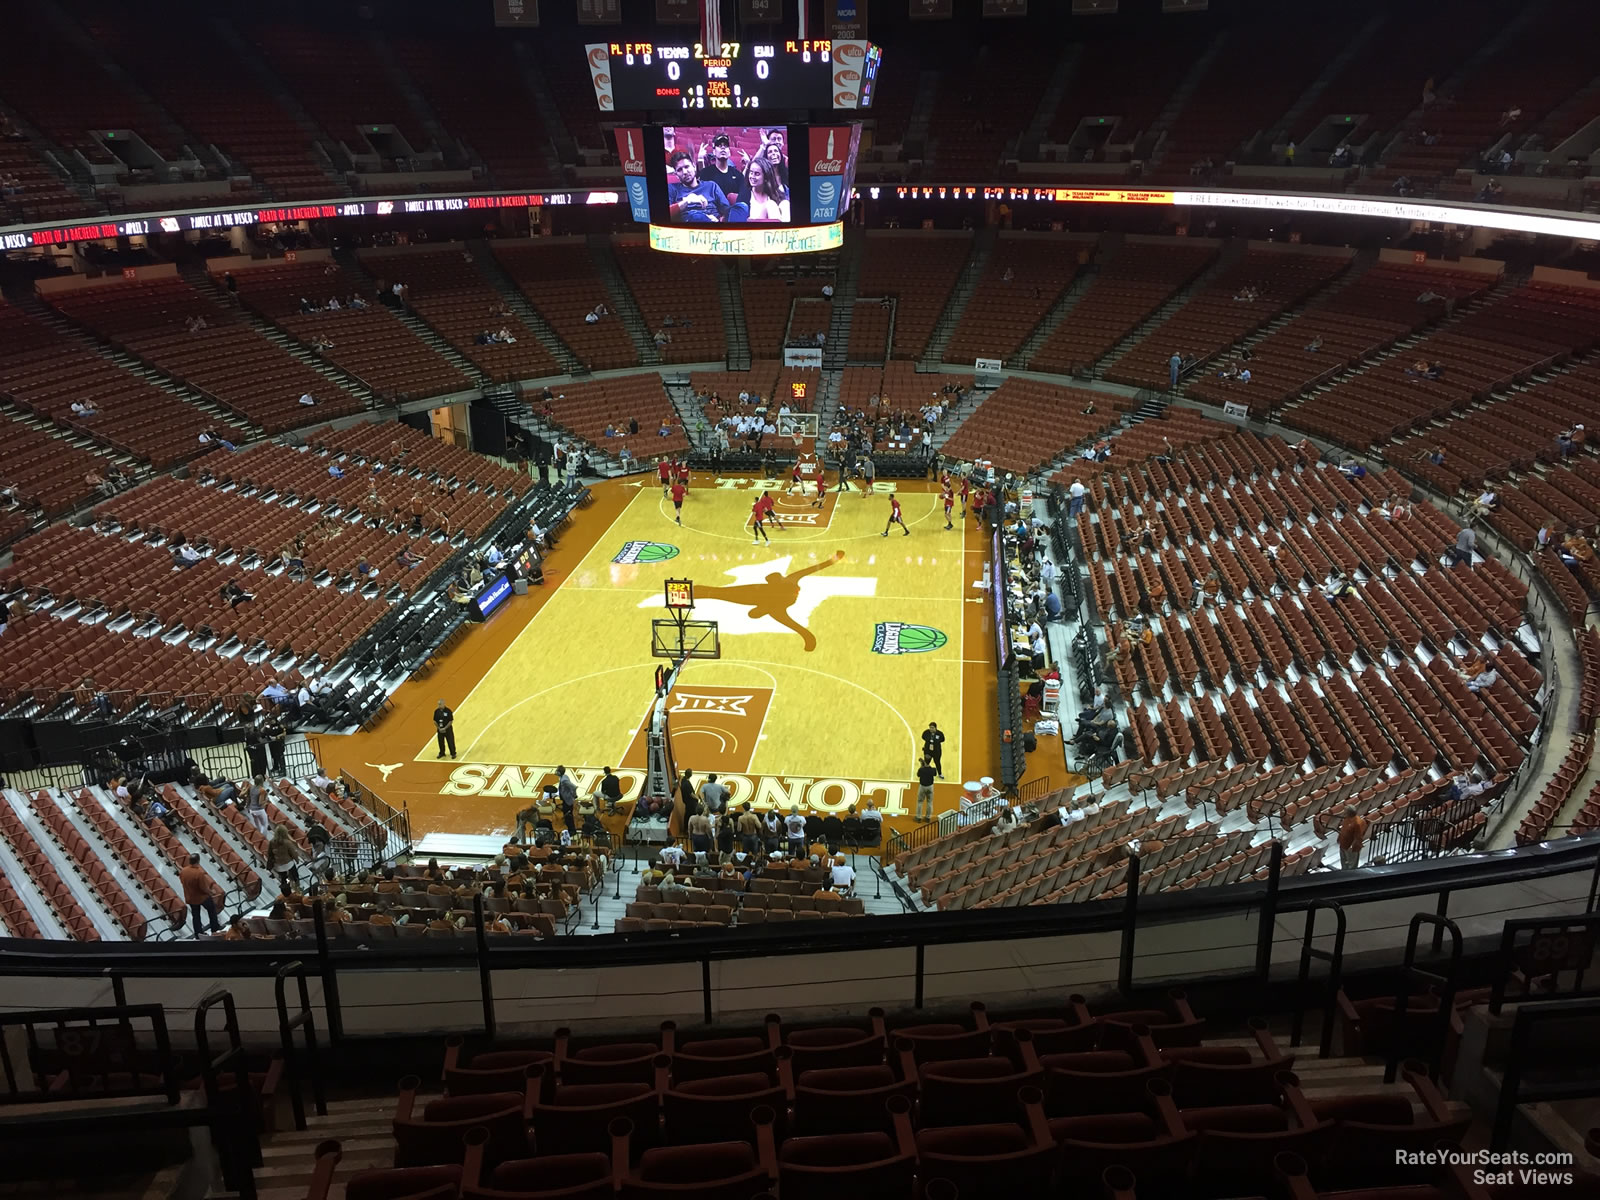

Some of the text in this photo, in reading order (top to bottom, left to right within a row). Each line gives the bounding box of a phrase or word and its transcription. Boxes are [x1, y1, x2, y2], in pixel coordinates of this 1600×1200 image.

[837, 9, 857, 17] NCAA
[837, 31, 855, 39] 2003
[611, 43, 652, 55] PL F PTS
[657, 47, 690, 59] TEXAS
[786, 41, 831, 53] PL F PTS
[626, 54, 651, 65] 0 0
[803, 51, 829, 62] 0 0
[703, 59, 732, 67] PERIOD
[668, 61, 680, 80] 0
[708, 67, 728, 78] PRE
[756, 60, 769, 79] 0
[708, 81, 728, 89] TEAM
[657, 88, 680, 96] BONUS
[707, 88, 731, 96] FOULS
[710, 97, 732, 108] TOL
[426, 199, 433, 211] AT
[435, 199, 444, 210] THE
[445, 198, 462, 210] DISCO
[469, 197, 486, 209] DEATH
[487, 197, 494, 208] OF
[502, 196, 527, 208] BACHELOR
[529, 194, 544, 206] TOUR
[550, 194, 566, 204] APRIL
[214, 214, 222, 226] AT
[222, 213, 235, 225] THE
[235, 212, 253, 224] DISCO
[258, 209, 277, 222] DEATH
[278, 209, 286, 221] OF
[293, 206, 320, 220] BACHELOR
[321, 205, 336, 217] TOUR
[344, 204, 359, 216] APRIL
[814, 208, 834, 218] AT&T
[5, 233, 27, 249] DISCO
[32, 231, 53, 245] DEATH
[54, 230, 62, 243] OF
[70, 226, 100, 241] BACHELOR
[101, 224, 118, 238] TOUR
[125, 221, 142, 235] APRIL
[793, 389, 805, 398] 30
[714, 477, 898, 493] TEXAS
[873, 625, 884, 651] CLASSIC
[881, 623, 902, 654] LEGENDS
[439, 763, 910, 815] LONGORNS
[62, 1031, 102, 1056] 87
